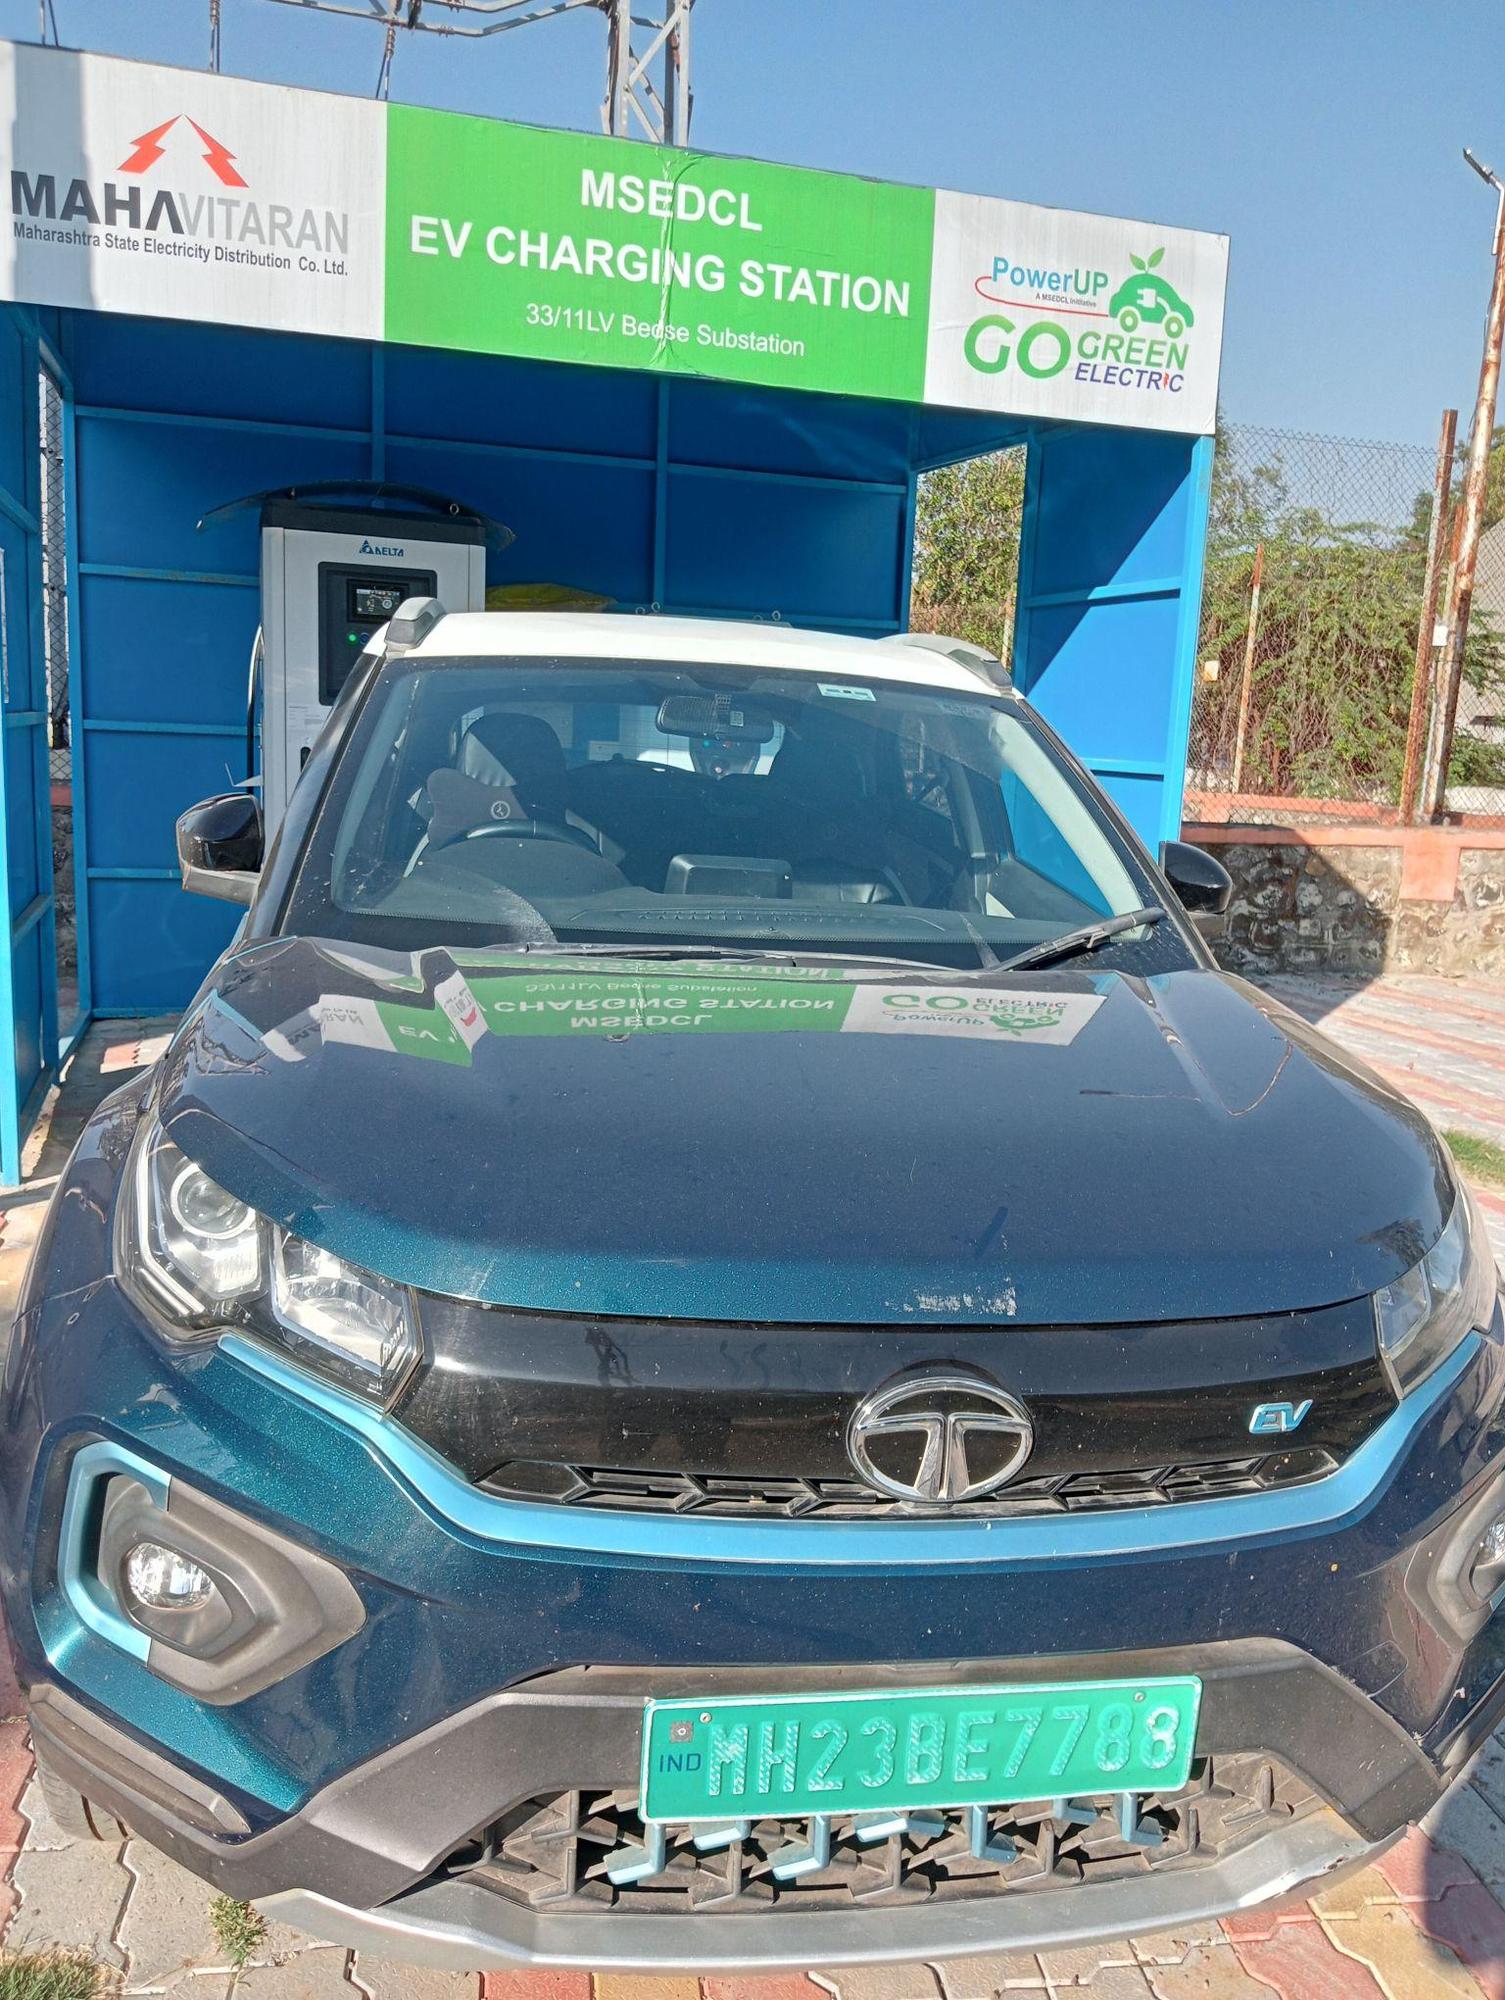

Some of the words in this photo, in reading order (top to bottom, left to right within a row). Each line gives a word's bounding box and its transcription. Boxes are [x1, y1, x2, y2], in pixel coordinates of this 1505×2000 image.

[581, 169, 762, 231] MSEDCL
[14, 222, 100, 246] Maharashtra
[105, 233, 140, 251] State
[144, 238, 210, 263] Electricity
[214, 247, 291, 270] Distribution
[299, 256, 320, 273] Co.
[324, 259, 348, 276] Ltd.
[411, 214, 472, 258] EV
[486, 226, 725, 292] CHARGING
[739, 259, 909, 317] STATION
[992, 256, 1109, 296] PowerUP
[1042, 293, 1069, 305] MSEDCL
[526, 303, 615, 333] 33/11LV
[622, 313, 690, 343] Bedse
[697, 324, 805, 356] Substation
[964, 314, 1071, 379] GO
[1077, 331, 1189, 371] GREEN
[1074, 362, 1184, 392] ELECTRIC
[375, 546, 404, 557] DELTA
[1249, 1399, 1313, 1434] EV
[659, 1752, 702, 1772] IND
[708, 1702, 1181, 1796] MH23BE7788
